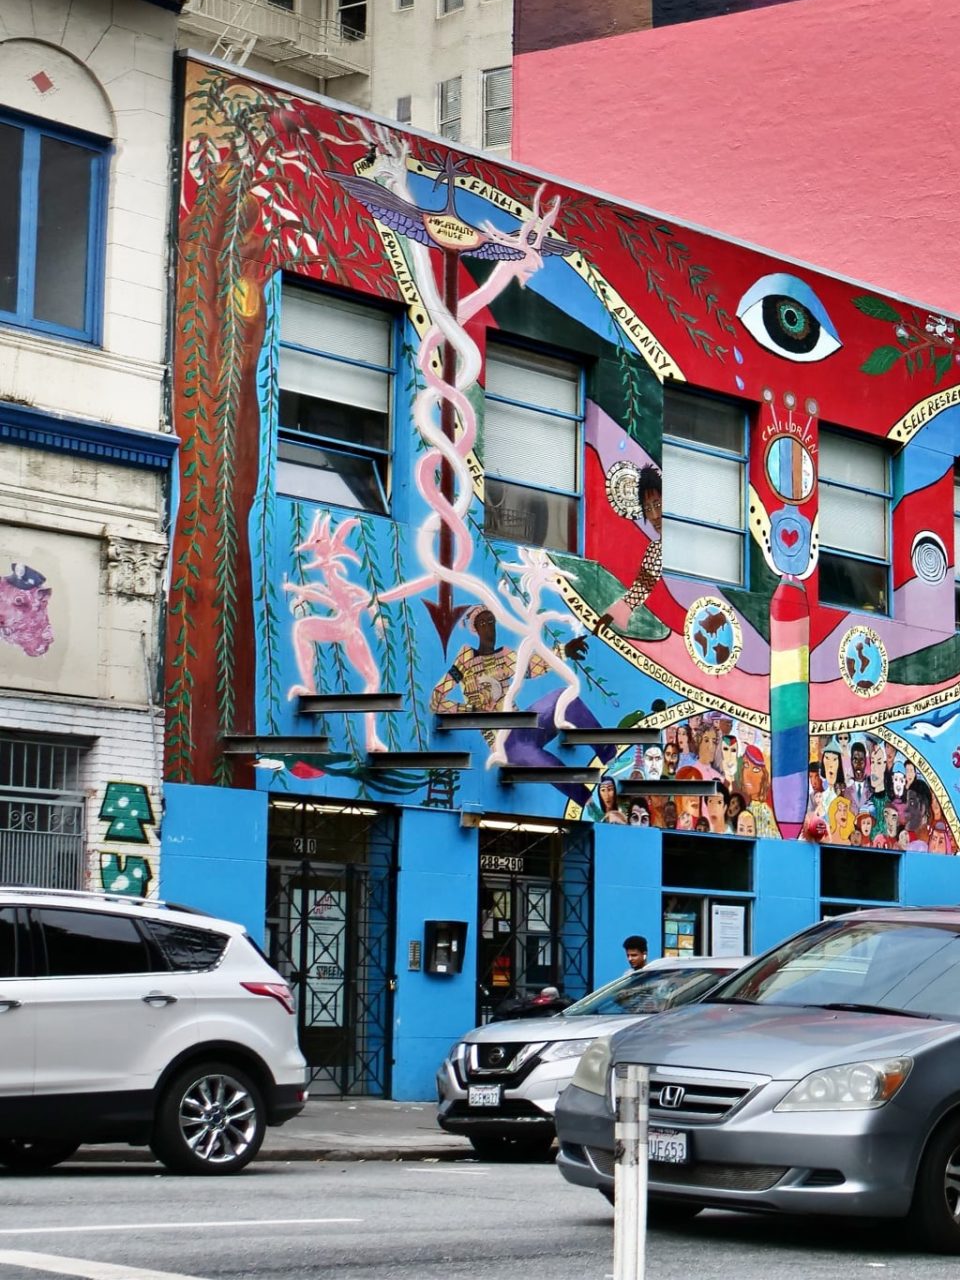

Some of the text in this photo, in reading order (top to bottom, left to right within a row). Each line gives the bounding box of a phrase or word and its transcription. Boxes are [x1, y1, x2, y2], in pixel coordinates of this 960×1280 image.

[469, 179, 513, 209] FAITH
[381, 231, 419, 303] EQUALITY
[613, 306, 671, 370] DIGNITY
[902, 408, 927, 436] SELF
[762, 420, 818, 454] CHILDREN
[568, 597, 593, 622] PAZ
[709, 698, 768, 726] MABUHAY!
[878, 705, 911, 723] EDUCATE
[913, 691, 950, 713] YOURSELF
[294, 838, 316, 854] 20
[481, 855, 524, 871] 288-290
[648, 1140, 685, 1159] UF653
